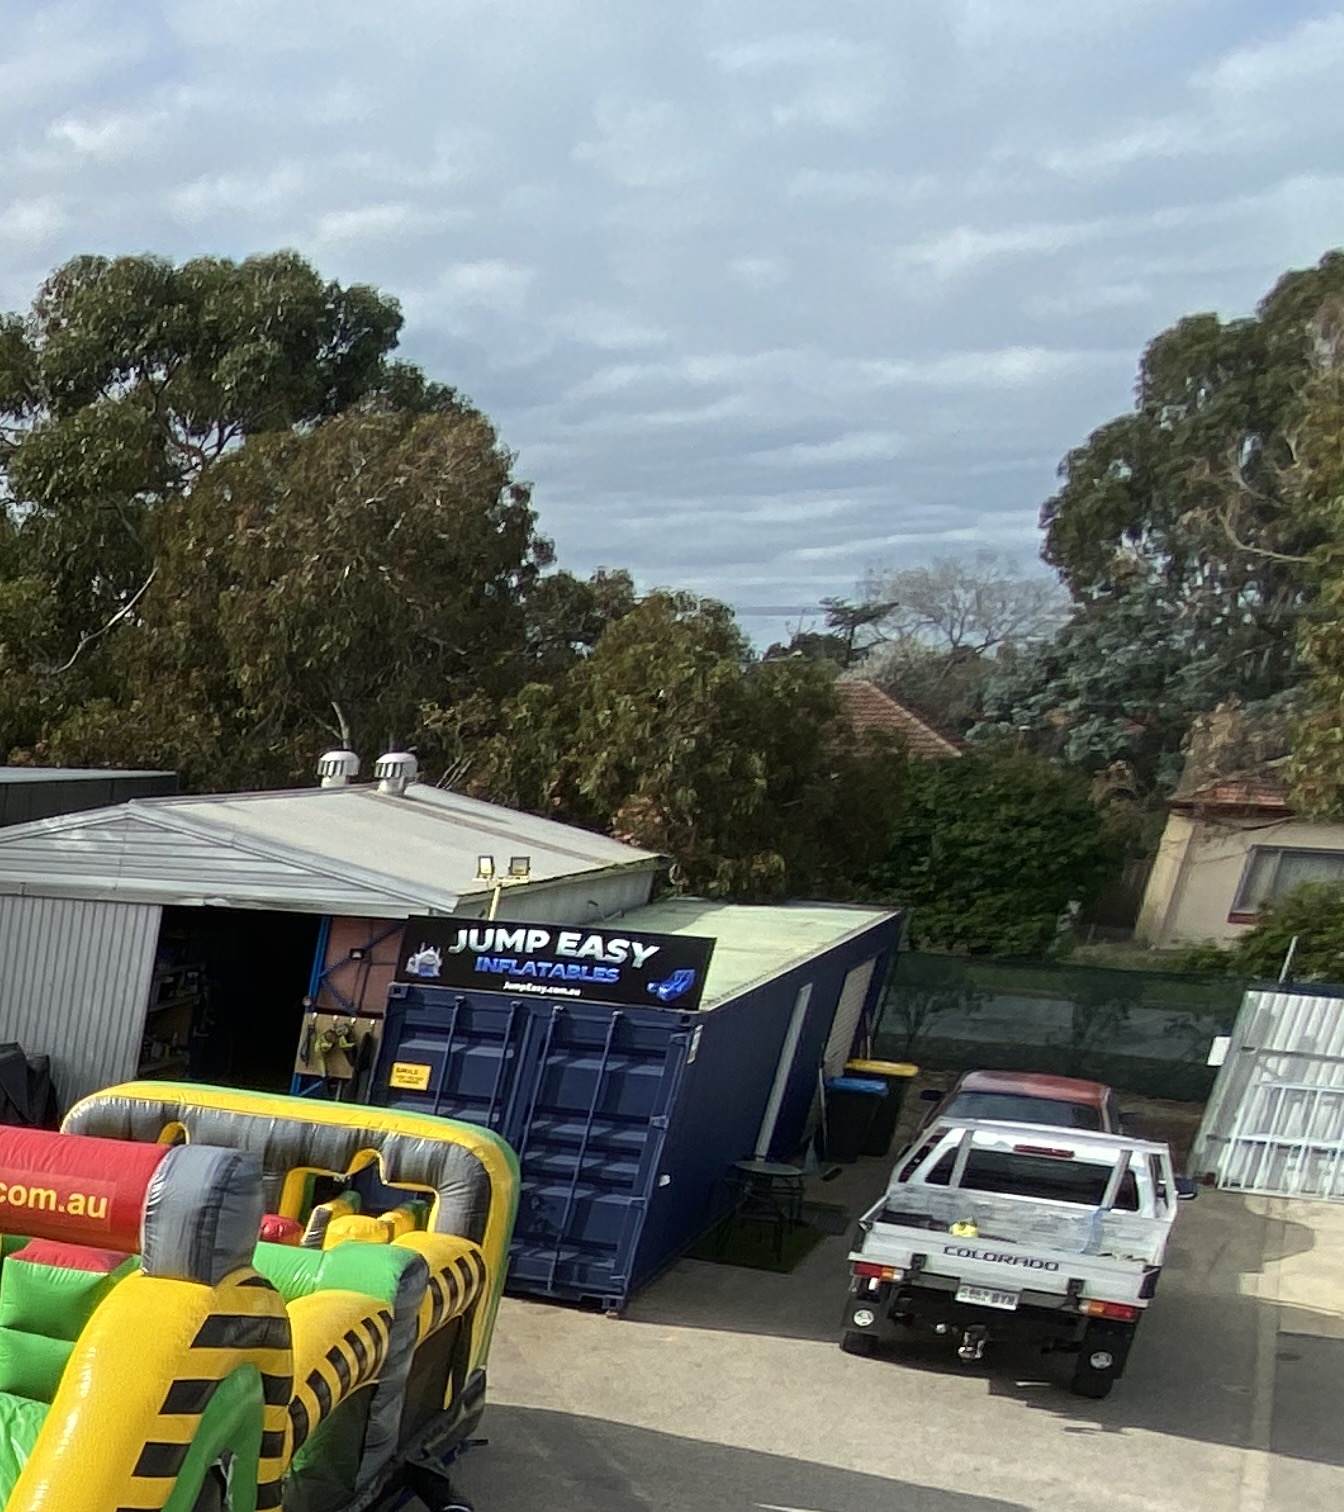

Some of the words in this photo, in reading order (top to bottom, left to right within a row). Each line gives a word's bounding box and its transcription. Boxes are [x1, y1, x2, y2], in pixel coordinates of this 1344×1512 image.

[448, 928, 550, 954] JUMP
[555, 931, 660, 970] EASY
[475, 955, 620, 983] INFLATABLES
[943, 1245, 1060, 1272] COLORADO
